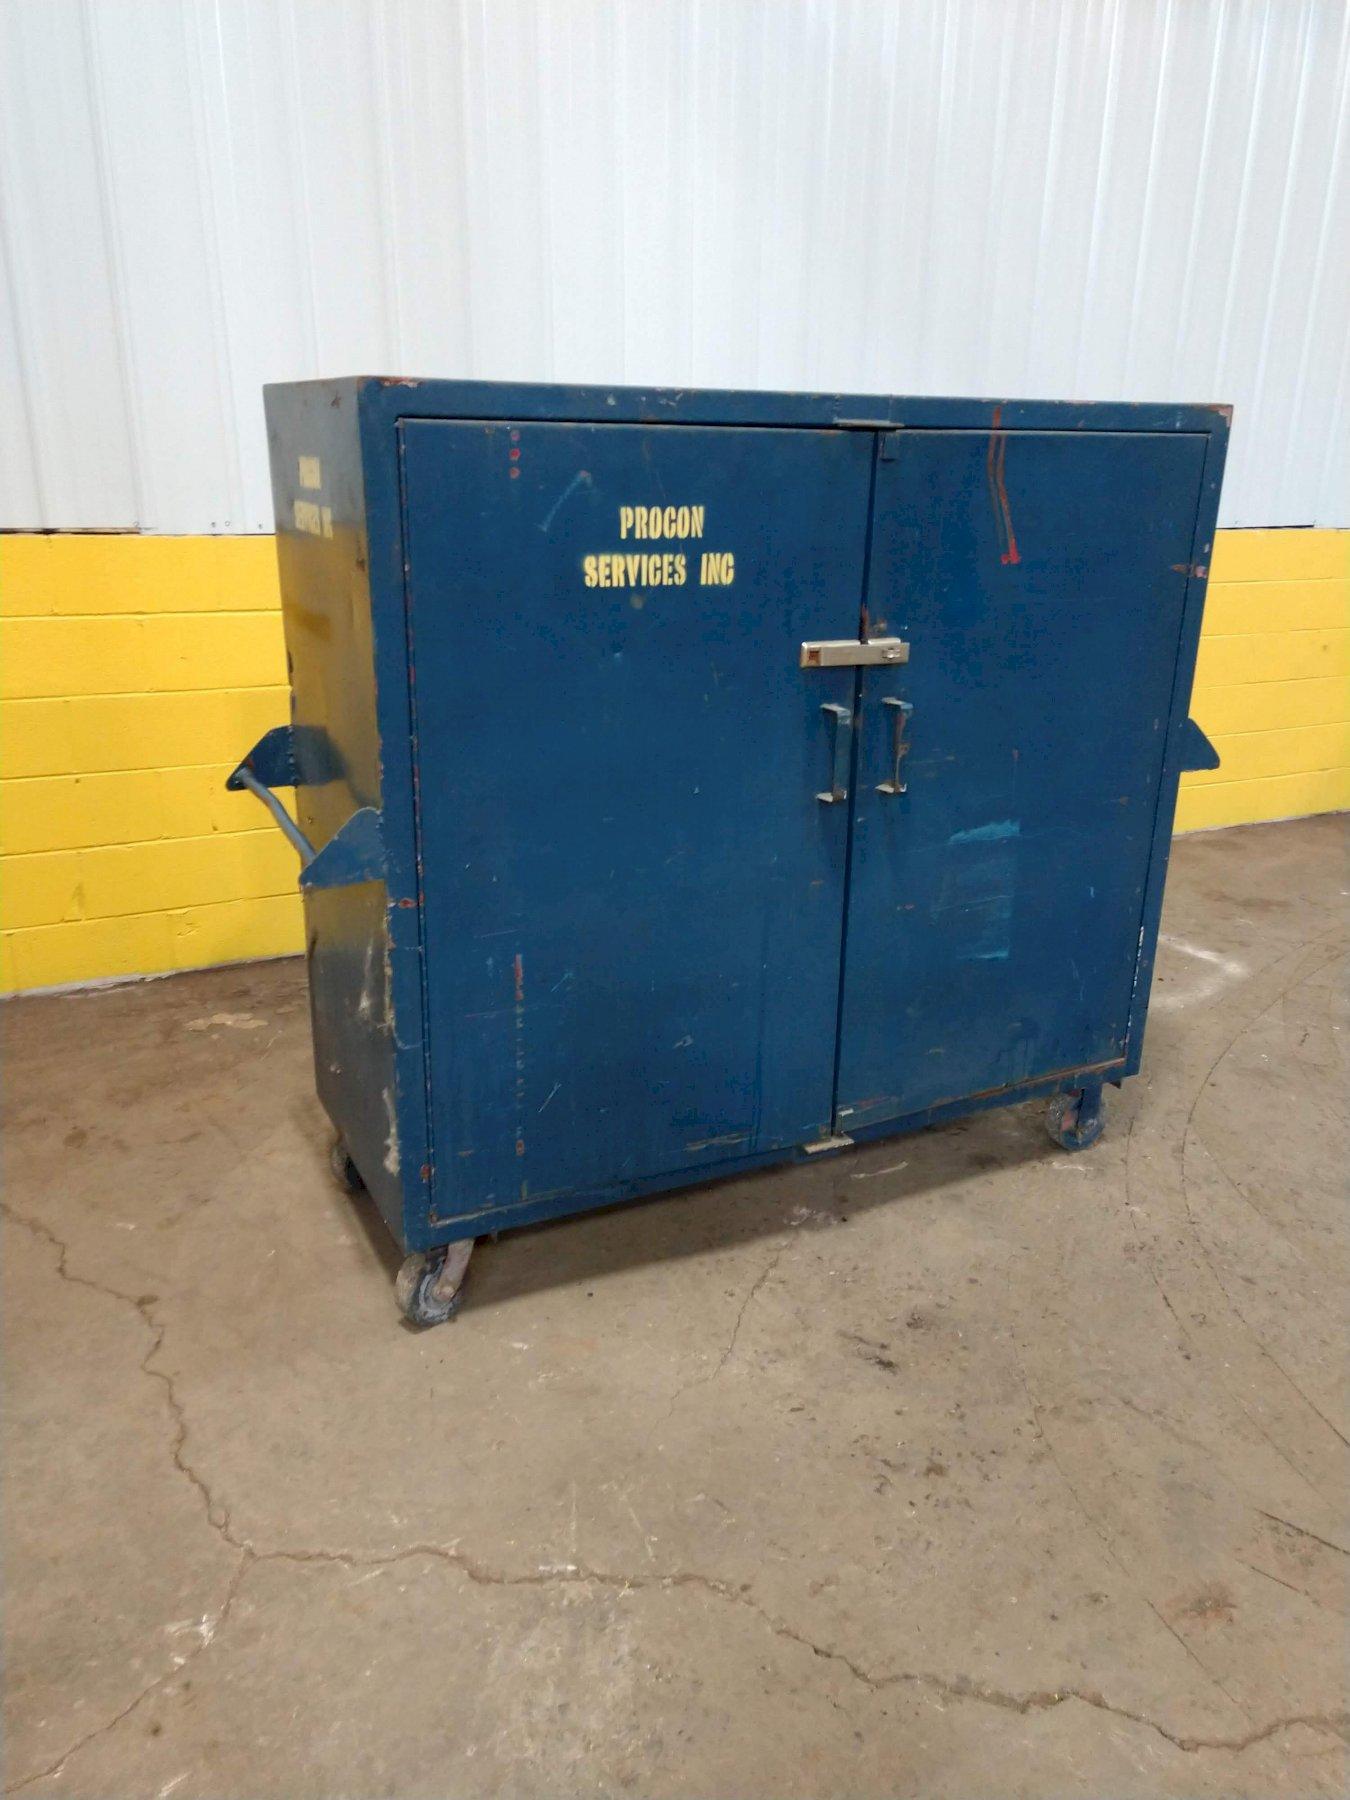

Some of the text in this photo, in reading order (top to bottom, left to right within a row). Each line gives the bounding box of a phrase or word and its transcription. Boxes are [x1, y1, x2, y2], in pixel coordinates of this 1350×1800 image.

[620, 505, 705, 539] PROCON
[584, 552, 735, 588] SERVICES INC
